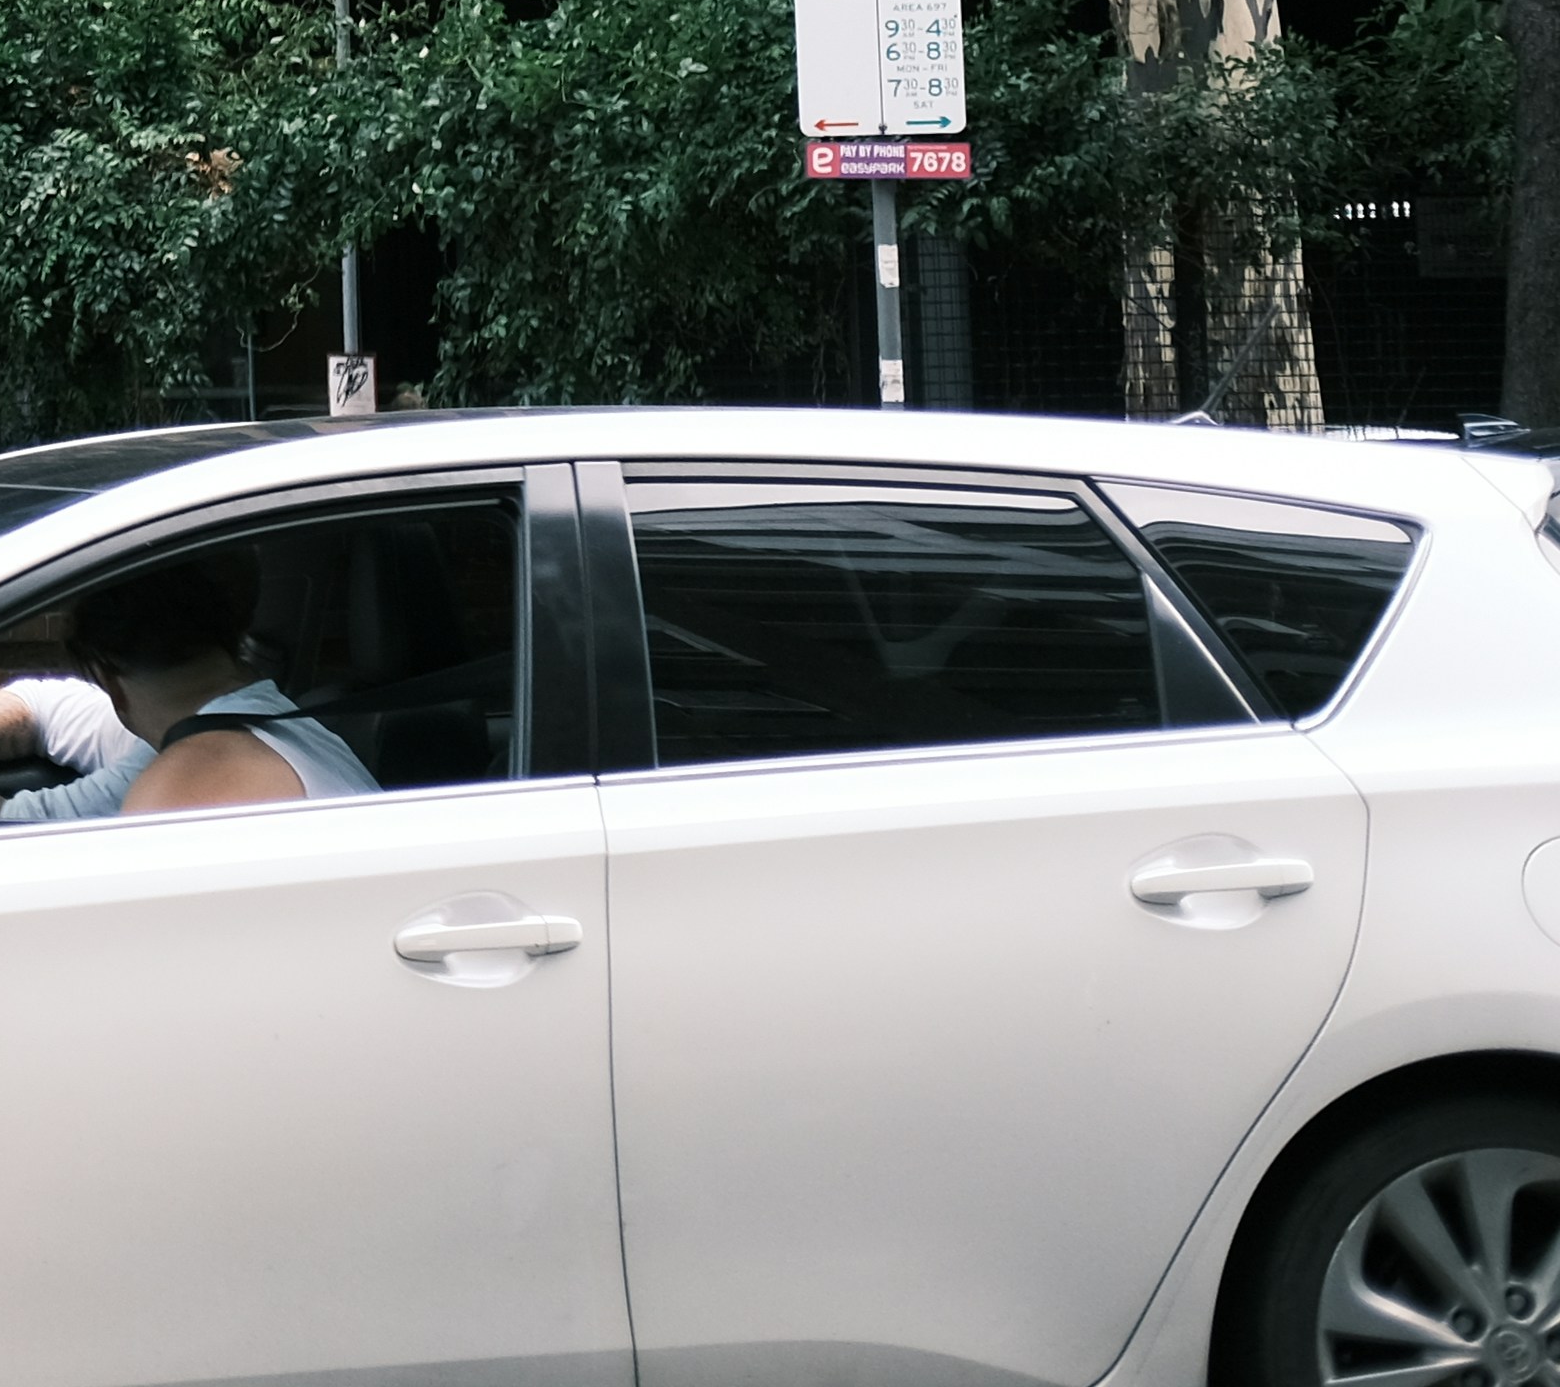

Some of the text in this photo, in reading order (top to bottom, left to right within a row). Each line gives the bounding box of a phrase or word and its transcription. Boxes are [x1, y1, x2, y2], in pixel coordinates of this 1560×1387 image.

[893, 2, 947, 12] AREA 697
[896, 65, 920, 73] MON
[930, 64, 948, 72] FRI
[913, 101, 935, 109] SAT
[840, 145, 858, 158] PAY
[859, 145, 872, 158] BY
[873, 145, 905, 158] PHONE
[909, 152, 967, 173] 7678
